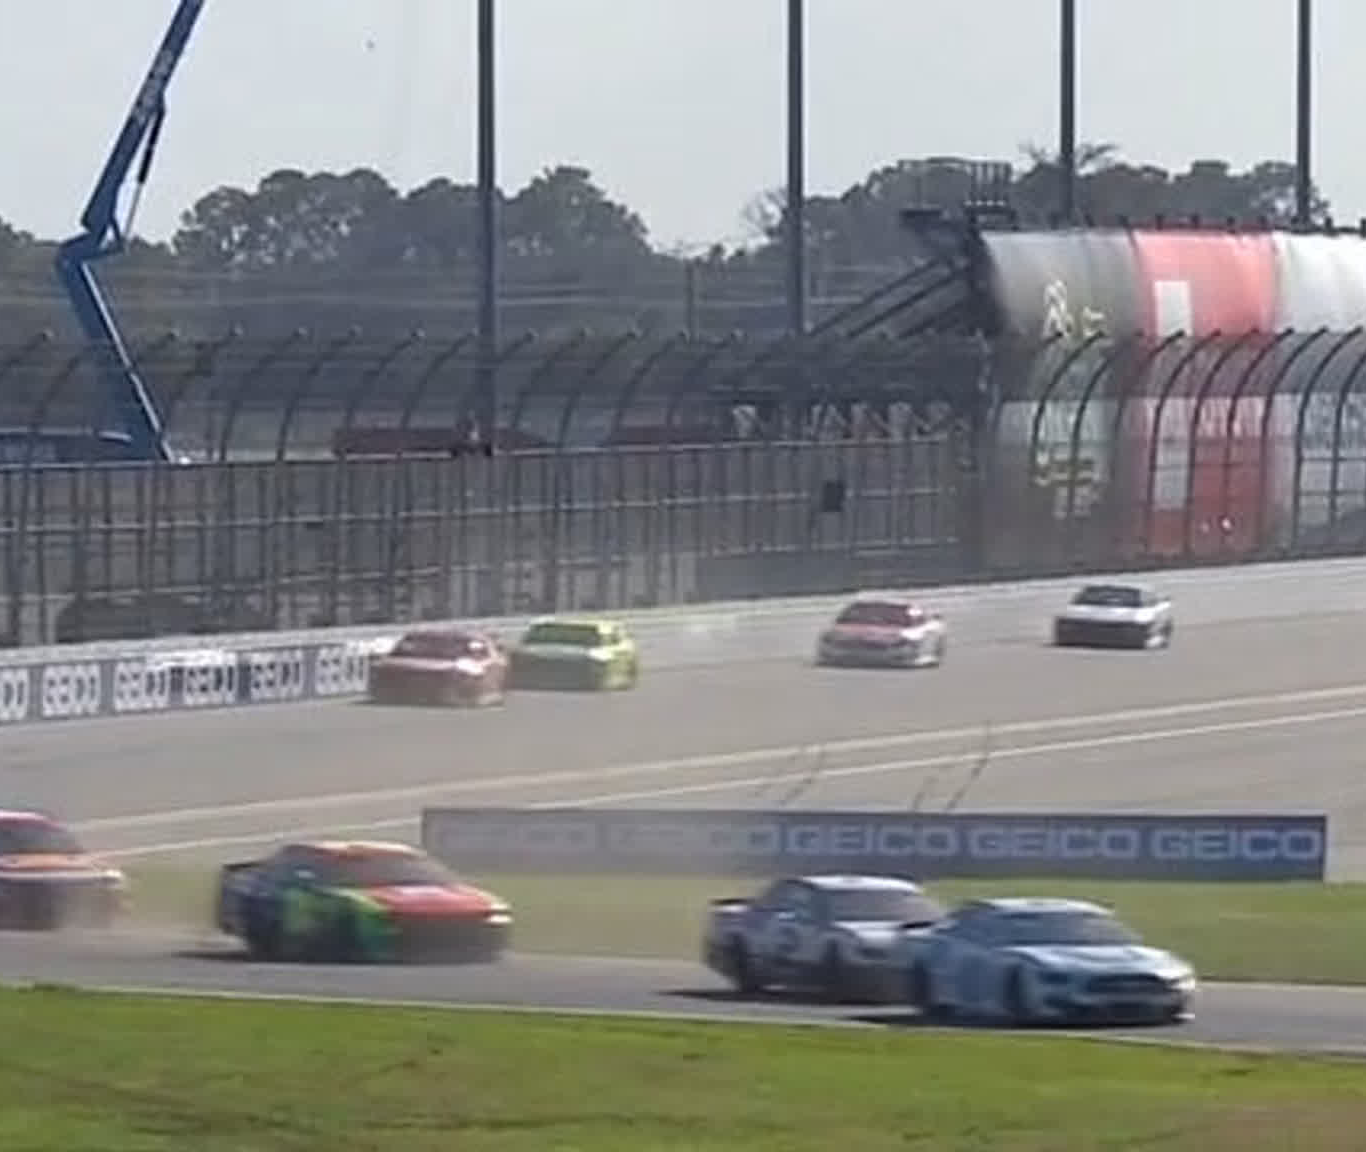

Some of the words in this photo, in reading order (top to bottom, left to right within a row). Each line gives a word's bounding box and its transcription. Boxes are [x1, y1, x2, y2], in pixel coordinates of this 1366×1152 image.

[785, 824, 958, 857] GEICO
[968, 826, 1135, 859] GEICO
[1151, 828, 1323, 861] GEICO
